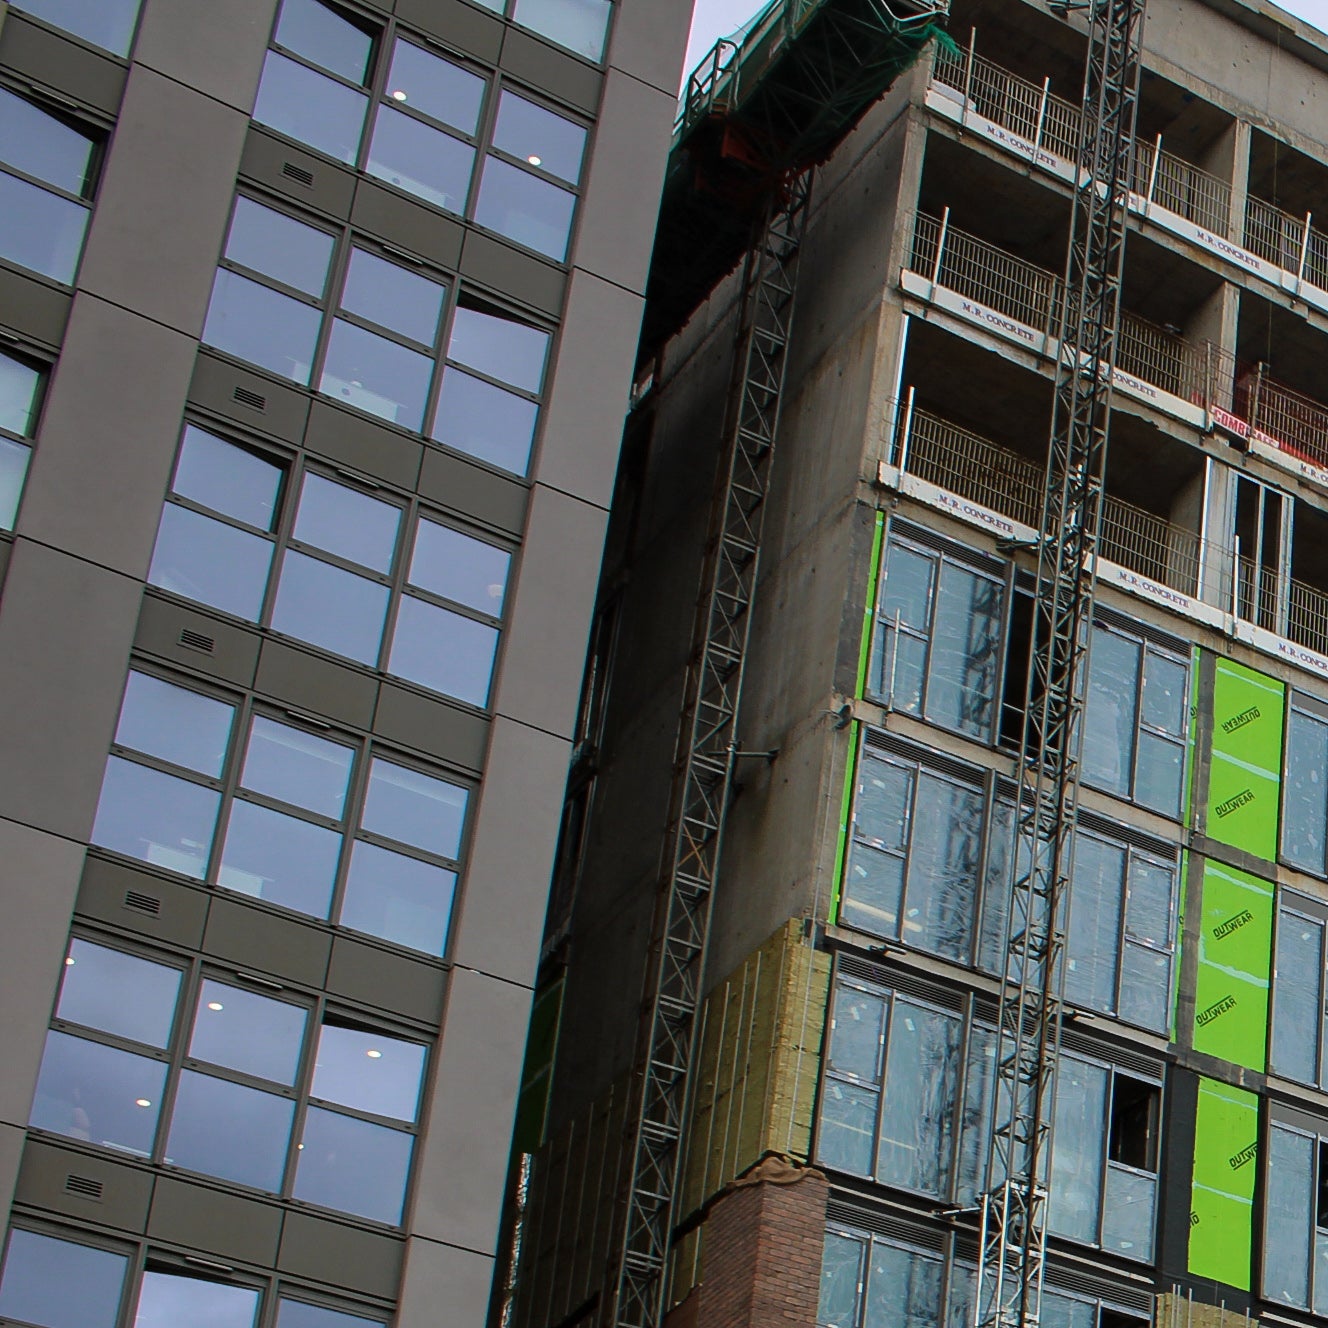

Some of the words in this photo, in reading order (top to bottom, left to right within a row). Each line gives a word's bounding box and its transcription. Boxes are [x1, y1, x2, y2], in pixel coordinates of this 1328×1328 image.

[1218, 239, 1260, 269] CONCRETE
[986, 316, 1034, 342] CONCRETE
[964, 505, 1014, 533] CONCRETE
[1142, 580, 1189, 608] CONCRETE
[1222, 708, 1261, 732] OUTWEAR
[1215, 791, 1255, 816] OUTWEAR
[1213, 911, 1254, 938] OUTWEAR
[1195, 997, 1237, 1025] OUTWEAR
